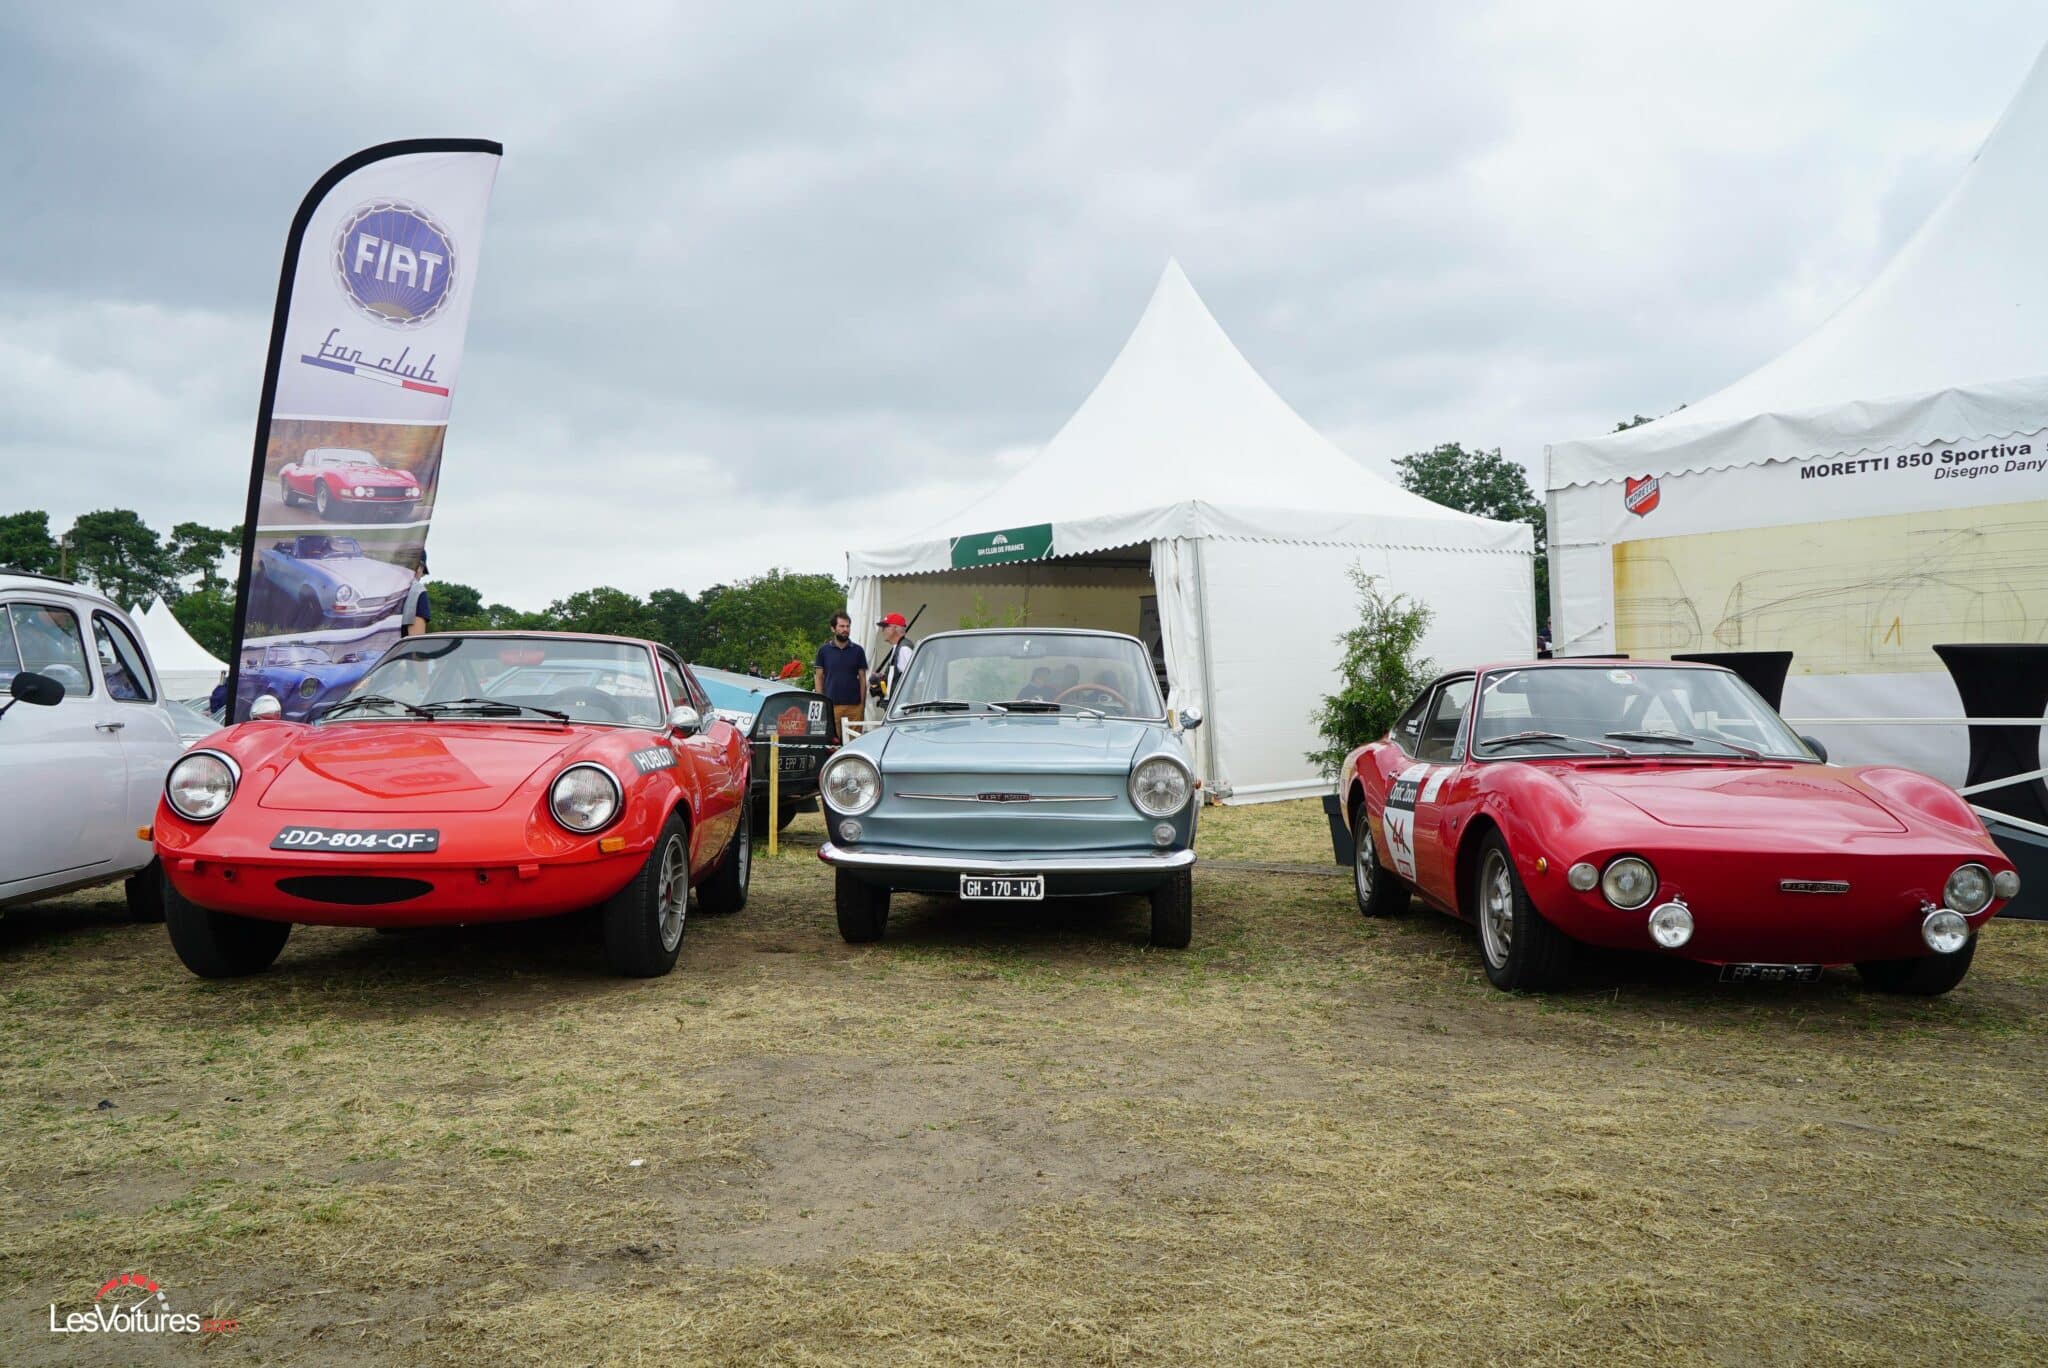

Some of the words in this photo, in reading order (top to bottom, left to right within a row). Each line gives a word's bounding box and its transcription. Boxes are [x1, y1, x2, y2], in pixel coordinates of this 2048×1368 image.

[354, 232, 443, 293] FIAT
[319, 328, 365, 364] fan
[378, 346, 438, 383] club
[1801, 457, 1889, 479] MORETTI
[1896, 452, 1934, 469] 850
[1940, 443, 2032, 466] Sportiva
[1934, 464, 1999, 480] Disegno
[2004, 459, 2048, 473] Dany
[1005, 543, 1025, 552] FRANCE
[810, 702, 820, 720] 83
[284, 829, 426, 849] DD-804-QF
